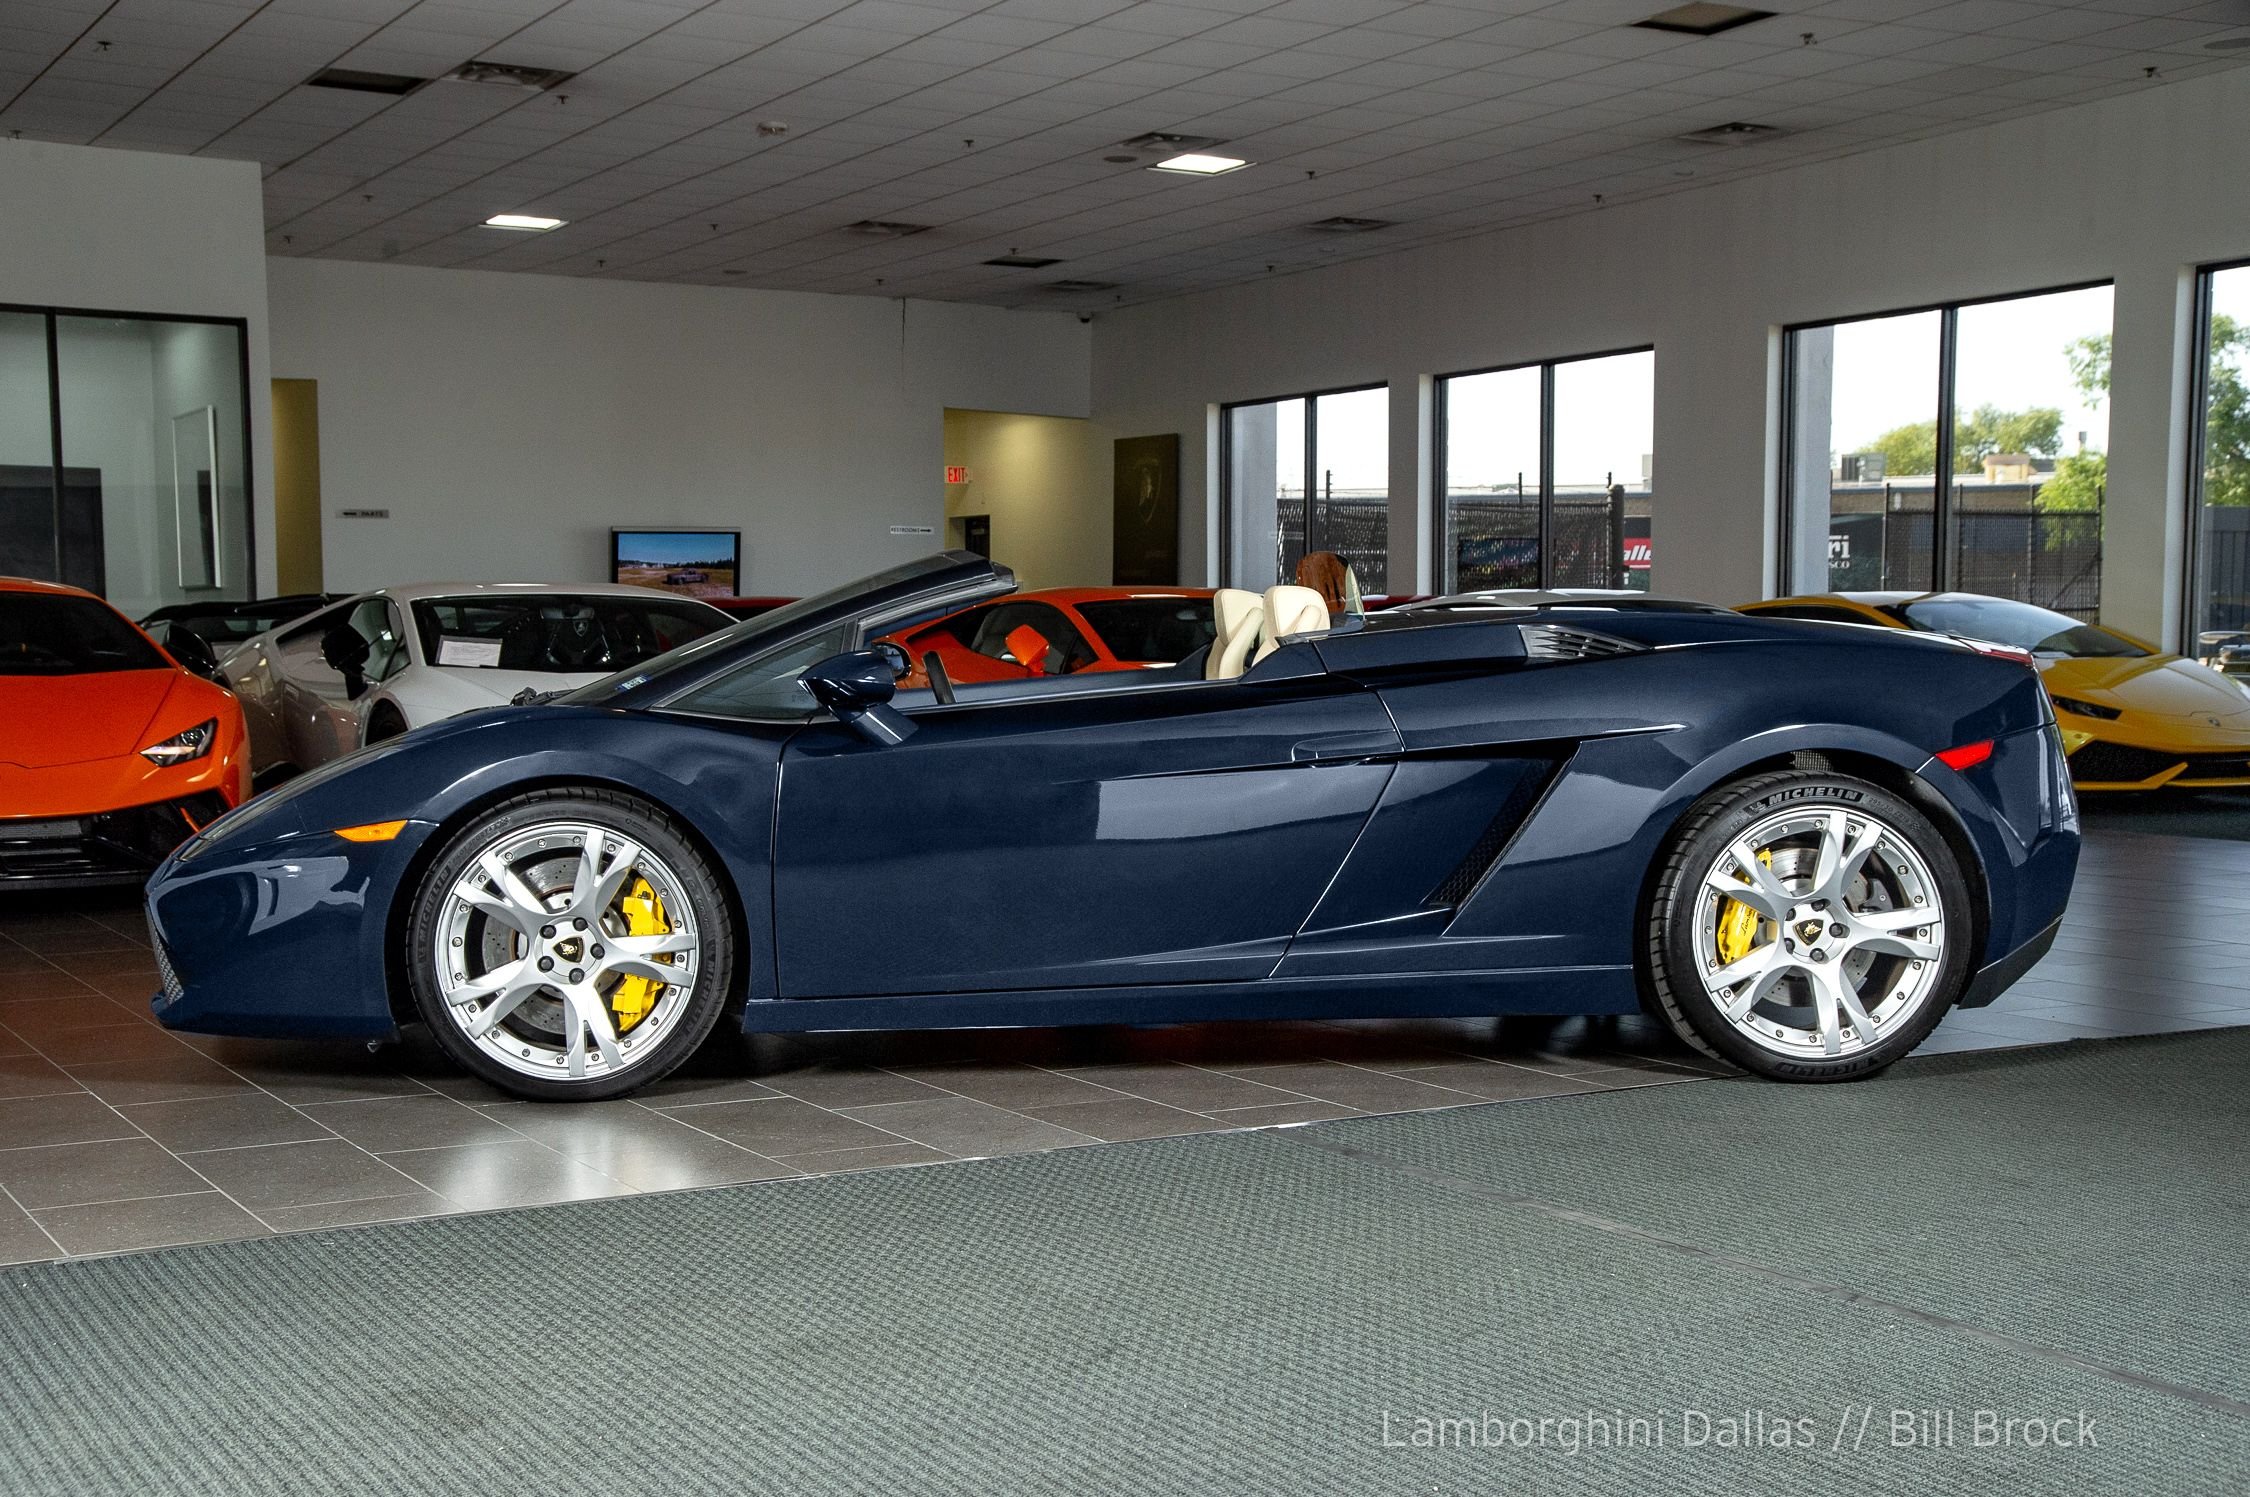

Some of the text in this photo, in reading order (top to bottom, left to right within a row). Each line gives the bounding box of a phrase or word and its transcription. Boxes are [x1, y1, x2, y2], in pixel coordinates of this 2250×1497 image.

[948, 467, 966, 482] EXIT
[1769, 787, 1860, 806] MICHELIN
[418, 867, 450, 942] MICHELIN
